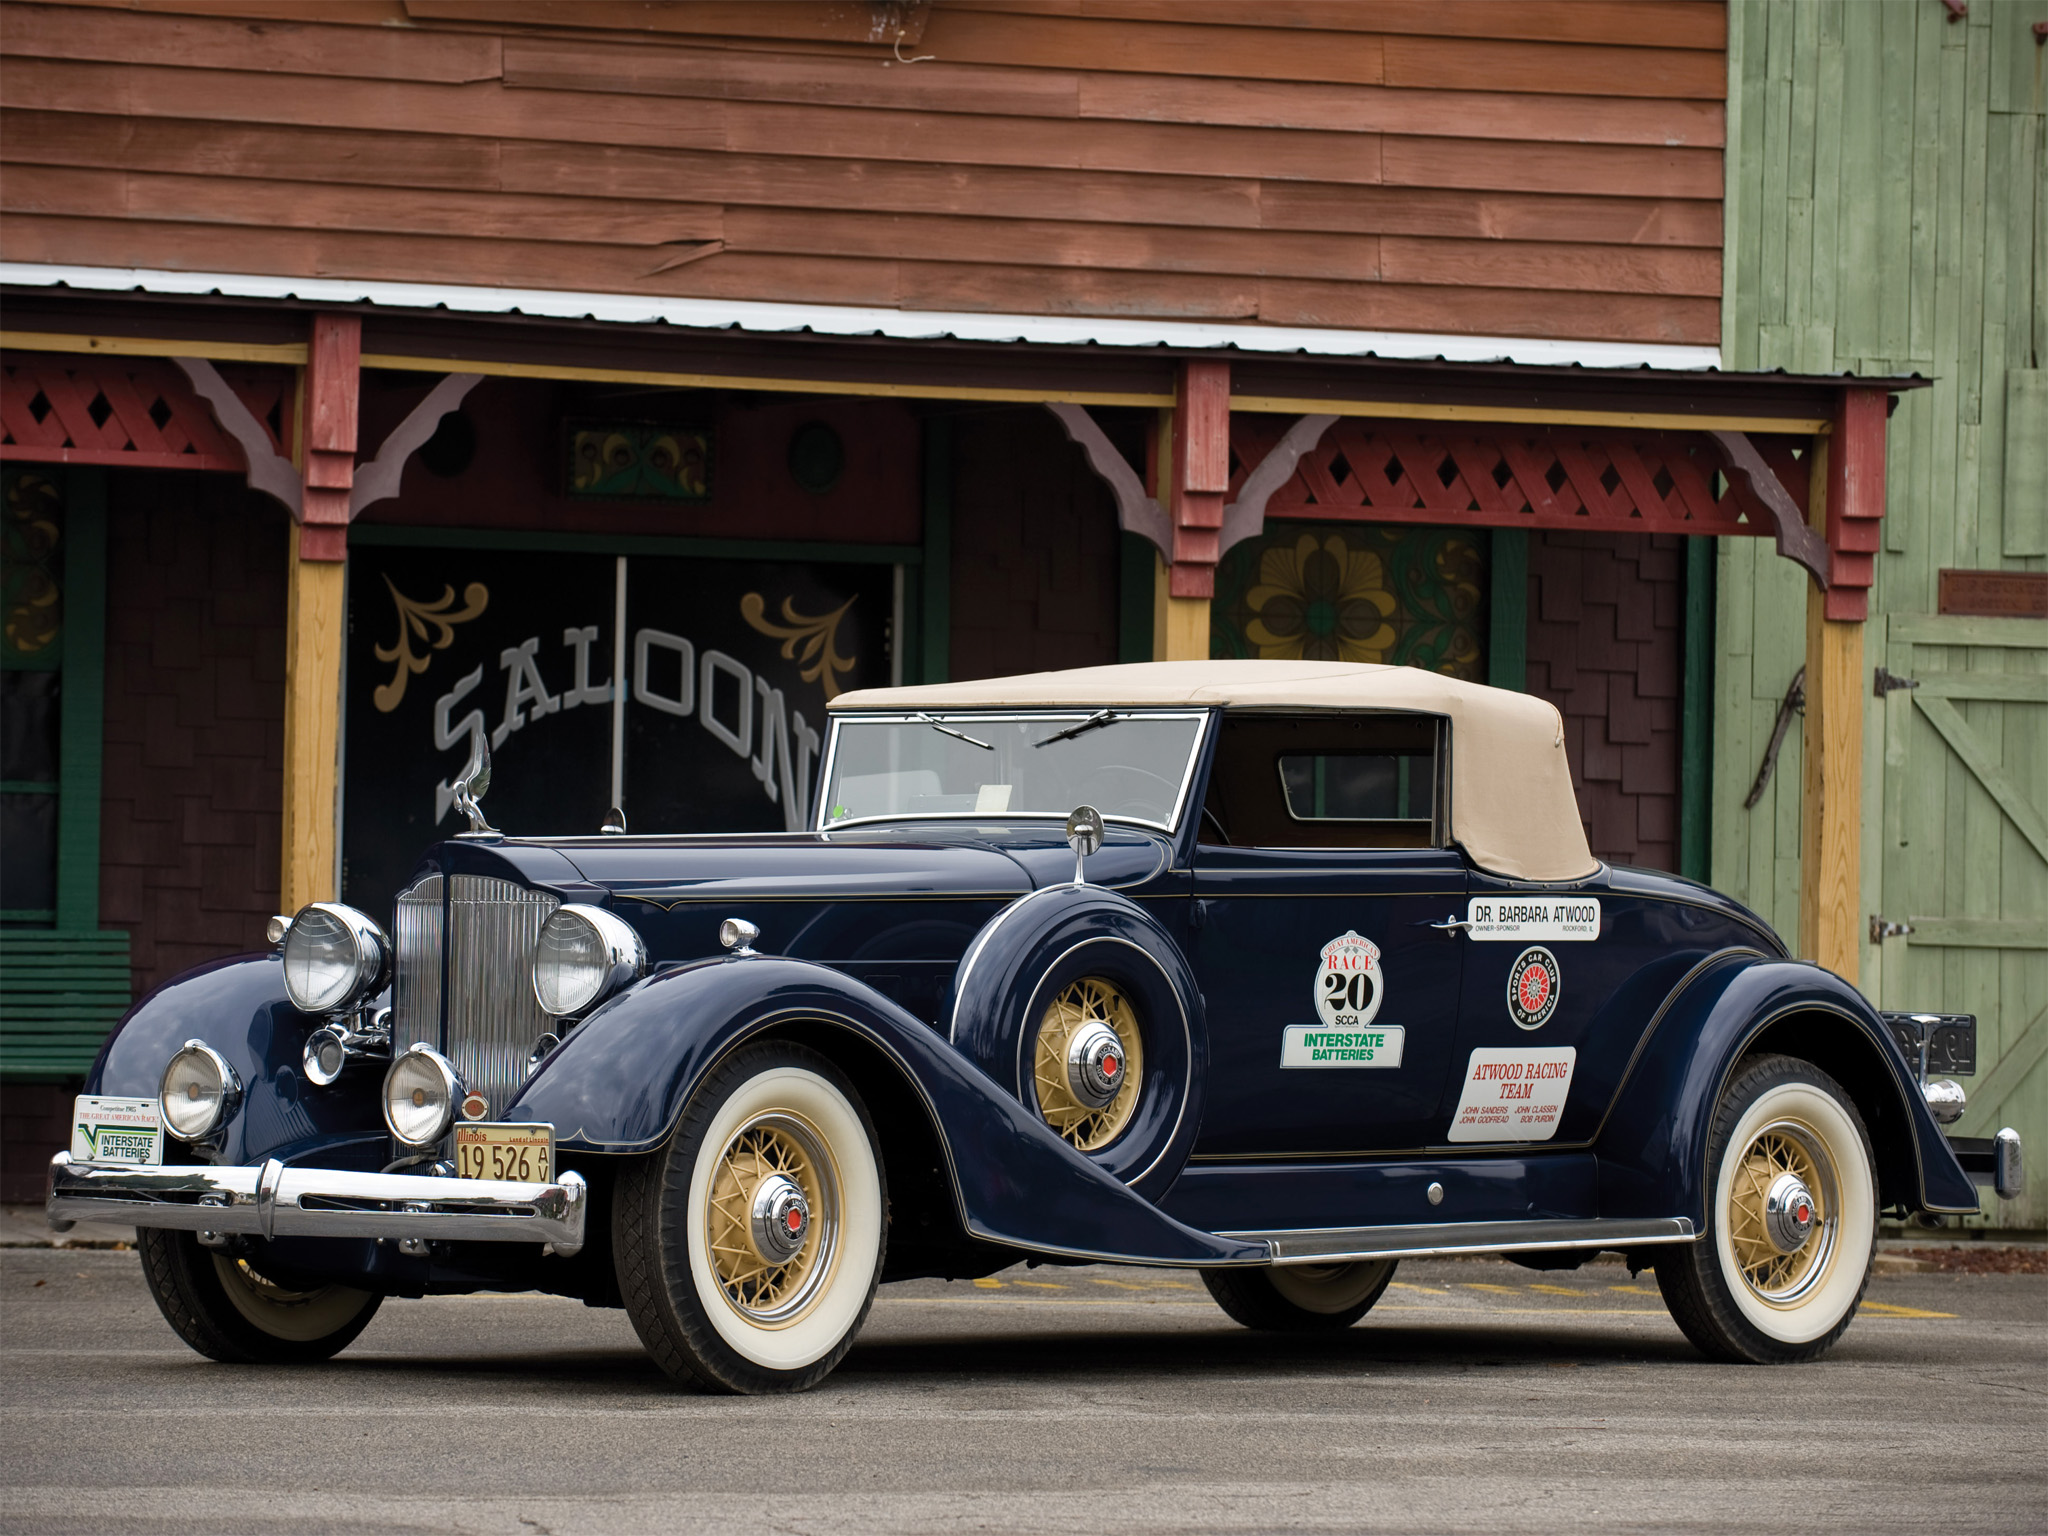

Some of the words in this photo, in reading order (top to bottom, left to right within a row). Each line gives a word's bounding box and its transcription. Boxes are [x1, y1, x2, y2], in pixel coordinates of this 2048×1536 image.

[434, 626, 820, 831] SALOON
[1475, 905, 1494, 923] DR.
[1499, 905, 1549, 923] BARBARA
[1553, 905, 1596, 923] ATWOOD
[1475, 924, 1521, 932] OWNER-SPONSOR
[1324, 938, 1344, 957] GREAT
[1346, 937, 1377, 957] AMERICAN
[1328, 954, 1374, 970] RACE
[1511, 960, 1527, 1002] SPORTS
[1528, 953, 1543, 963] CAR
[1544, 958, 1557, 984] CLUB
[1324, 972, 1374, 1011] 20
[1517, 1008, 1527, 1020] OF
[1527, 994, 1555, 1023] AMERICA
[1335, 1014, 1359, 1026] SCCA
[1303, 1033, 1385, 1048] INTERSTATE
[1311, 1048, 1374, 1061] BATTERIES
[1472, 1063, 1523, 1081] ATWOOD
[1525, 1062, 1568, 1079] RACING
[1499, 1083, 1534, 1099] TEAM
[79, 1112, 90, 1120] THE
[1462, 1106, 1479, 1115] JOHN
[1481, 1106, 1508, 1115] SANDERS
[1514, 1105, 1531, 1114] JOHN
[1532, 1105, 1558, 1114] CLASSEN
[1459, 1115, 1476, 1124] JOHN
[1520, 1114, 1533, 1123] BOB
[101, 1135, 153, 1148] INTERSTATE
[457, 1128, 487, 1142] Illinois
[103, 1147, 151, 1159] BATTERIES
[461, 1145, 485, 1180] 19
[492, 1145, 530, 1181] 526
